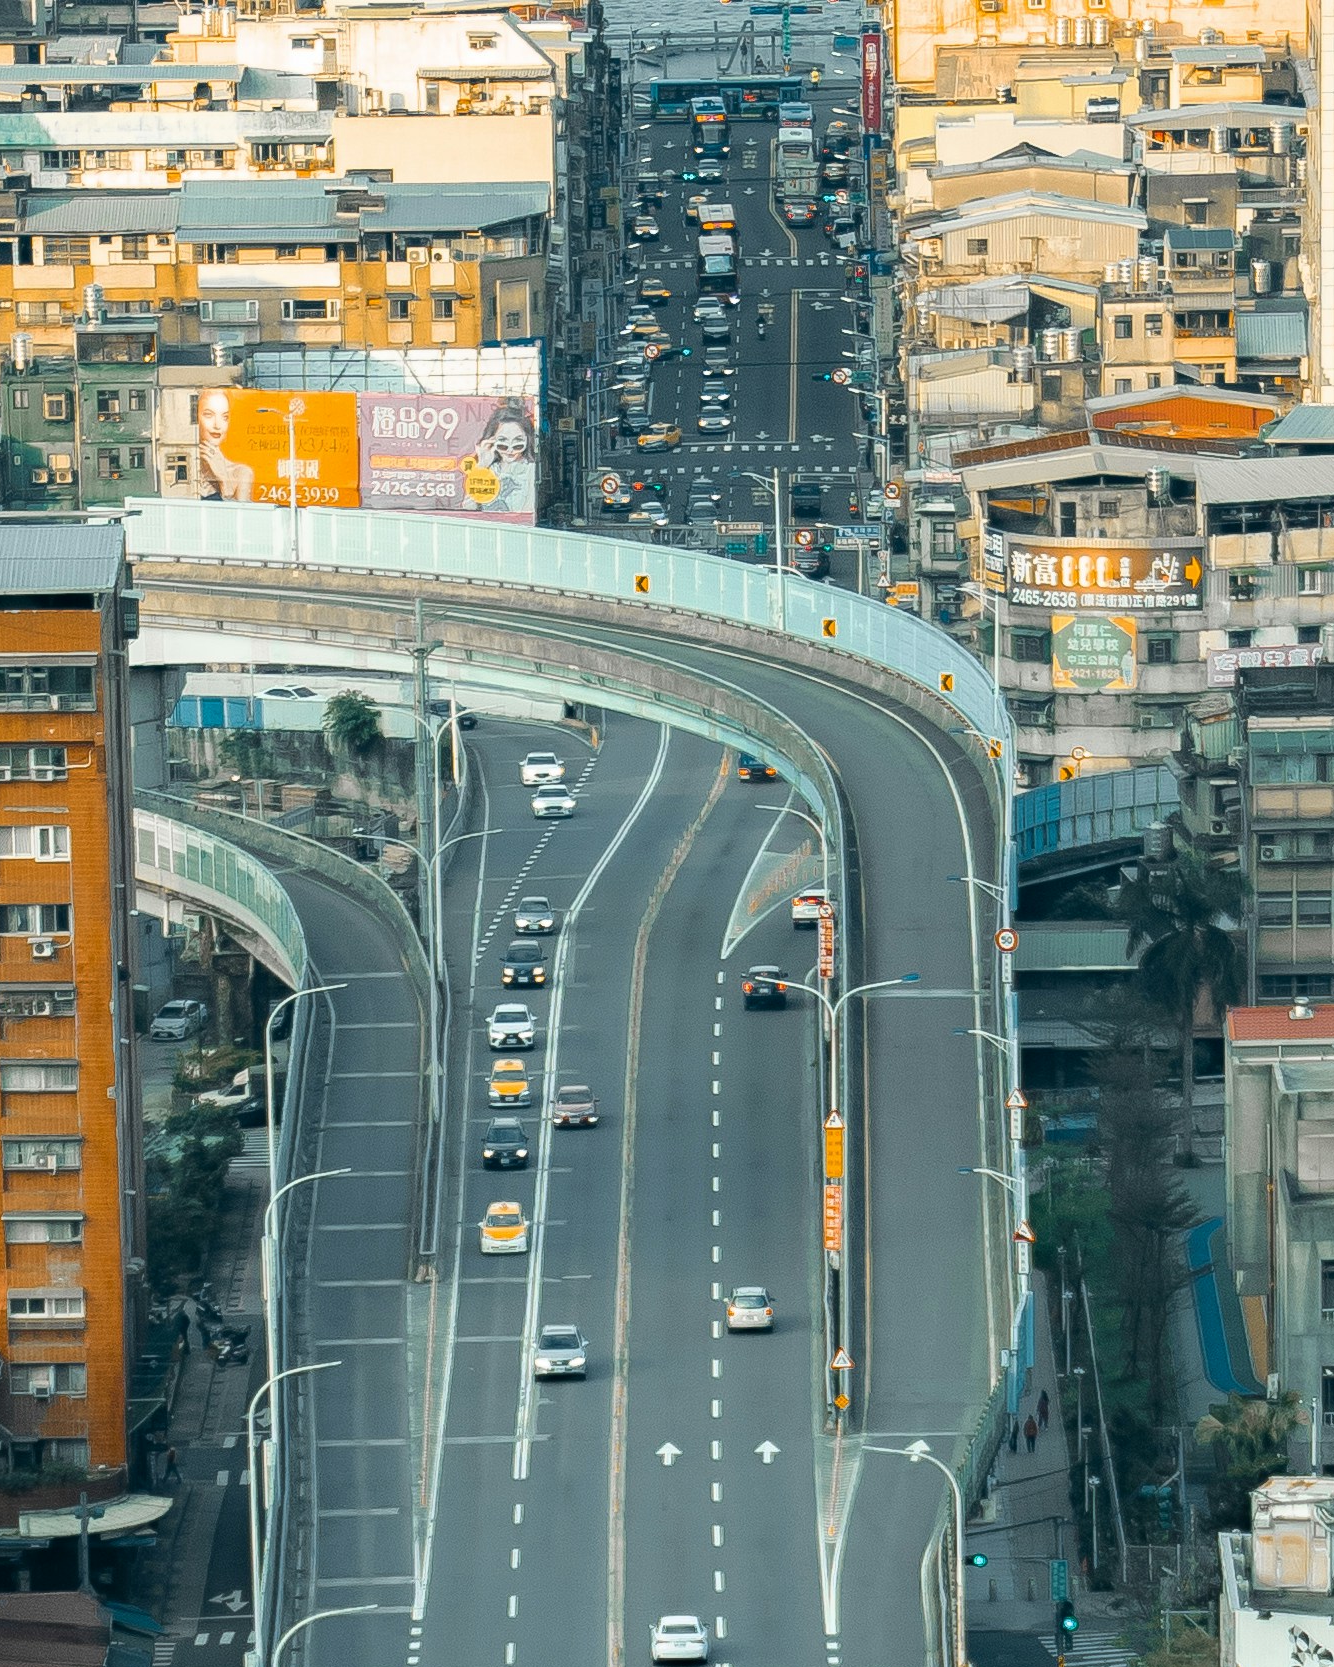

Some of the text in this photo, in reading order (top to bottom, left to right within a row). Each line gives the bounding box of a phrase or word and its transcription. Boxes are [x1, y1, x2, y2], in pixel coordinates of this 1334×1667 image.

[372, 406, 459, 440] 橙品99
[371, 481, 456, 497] 2426-6568
[1012, 588, 1077, 608] 2465-2636
[1001, 935, 1013, 945] 50
